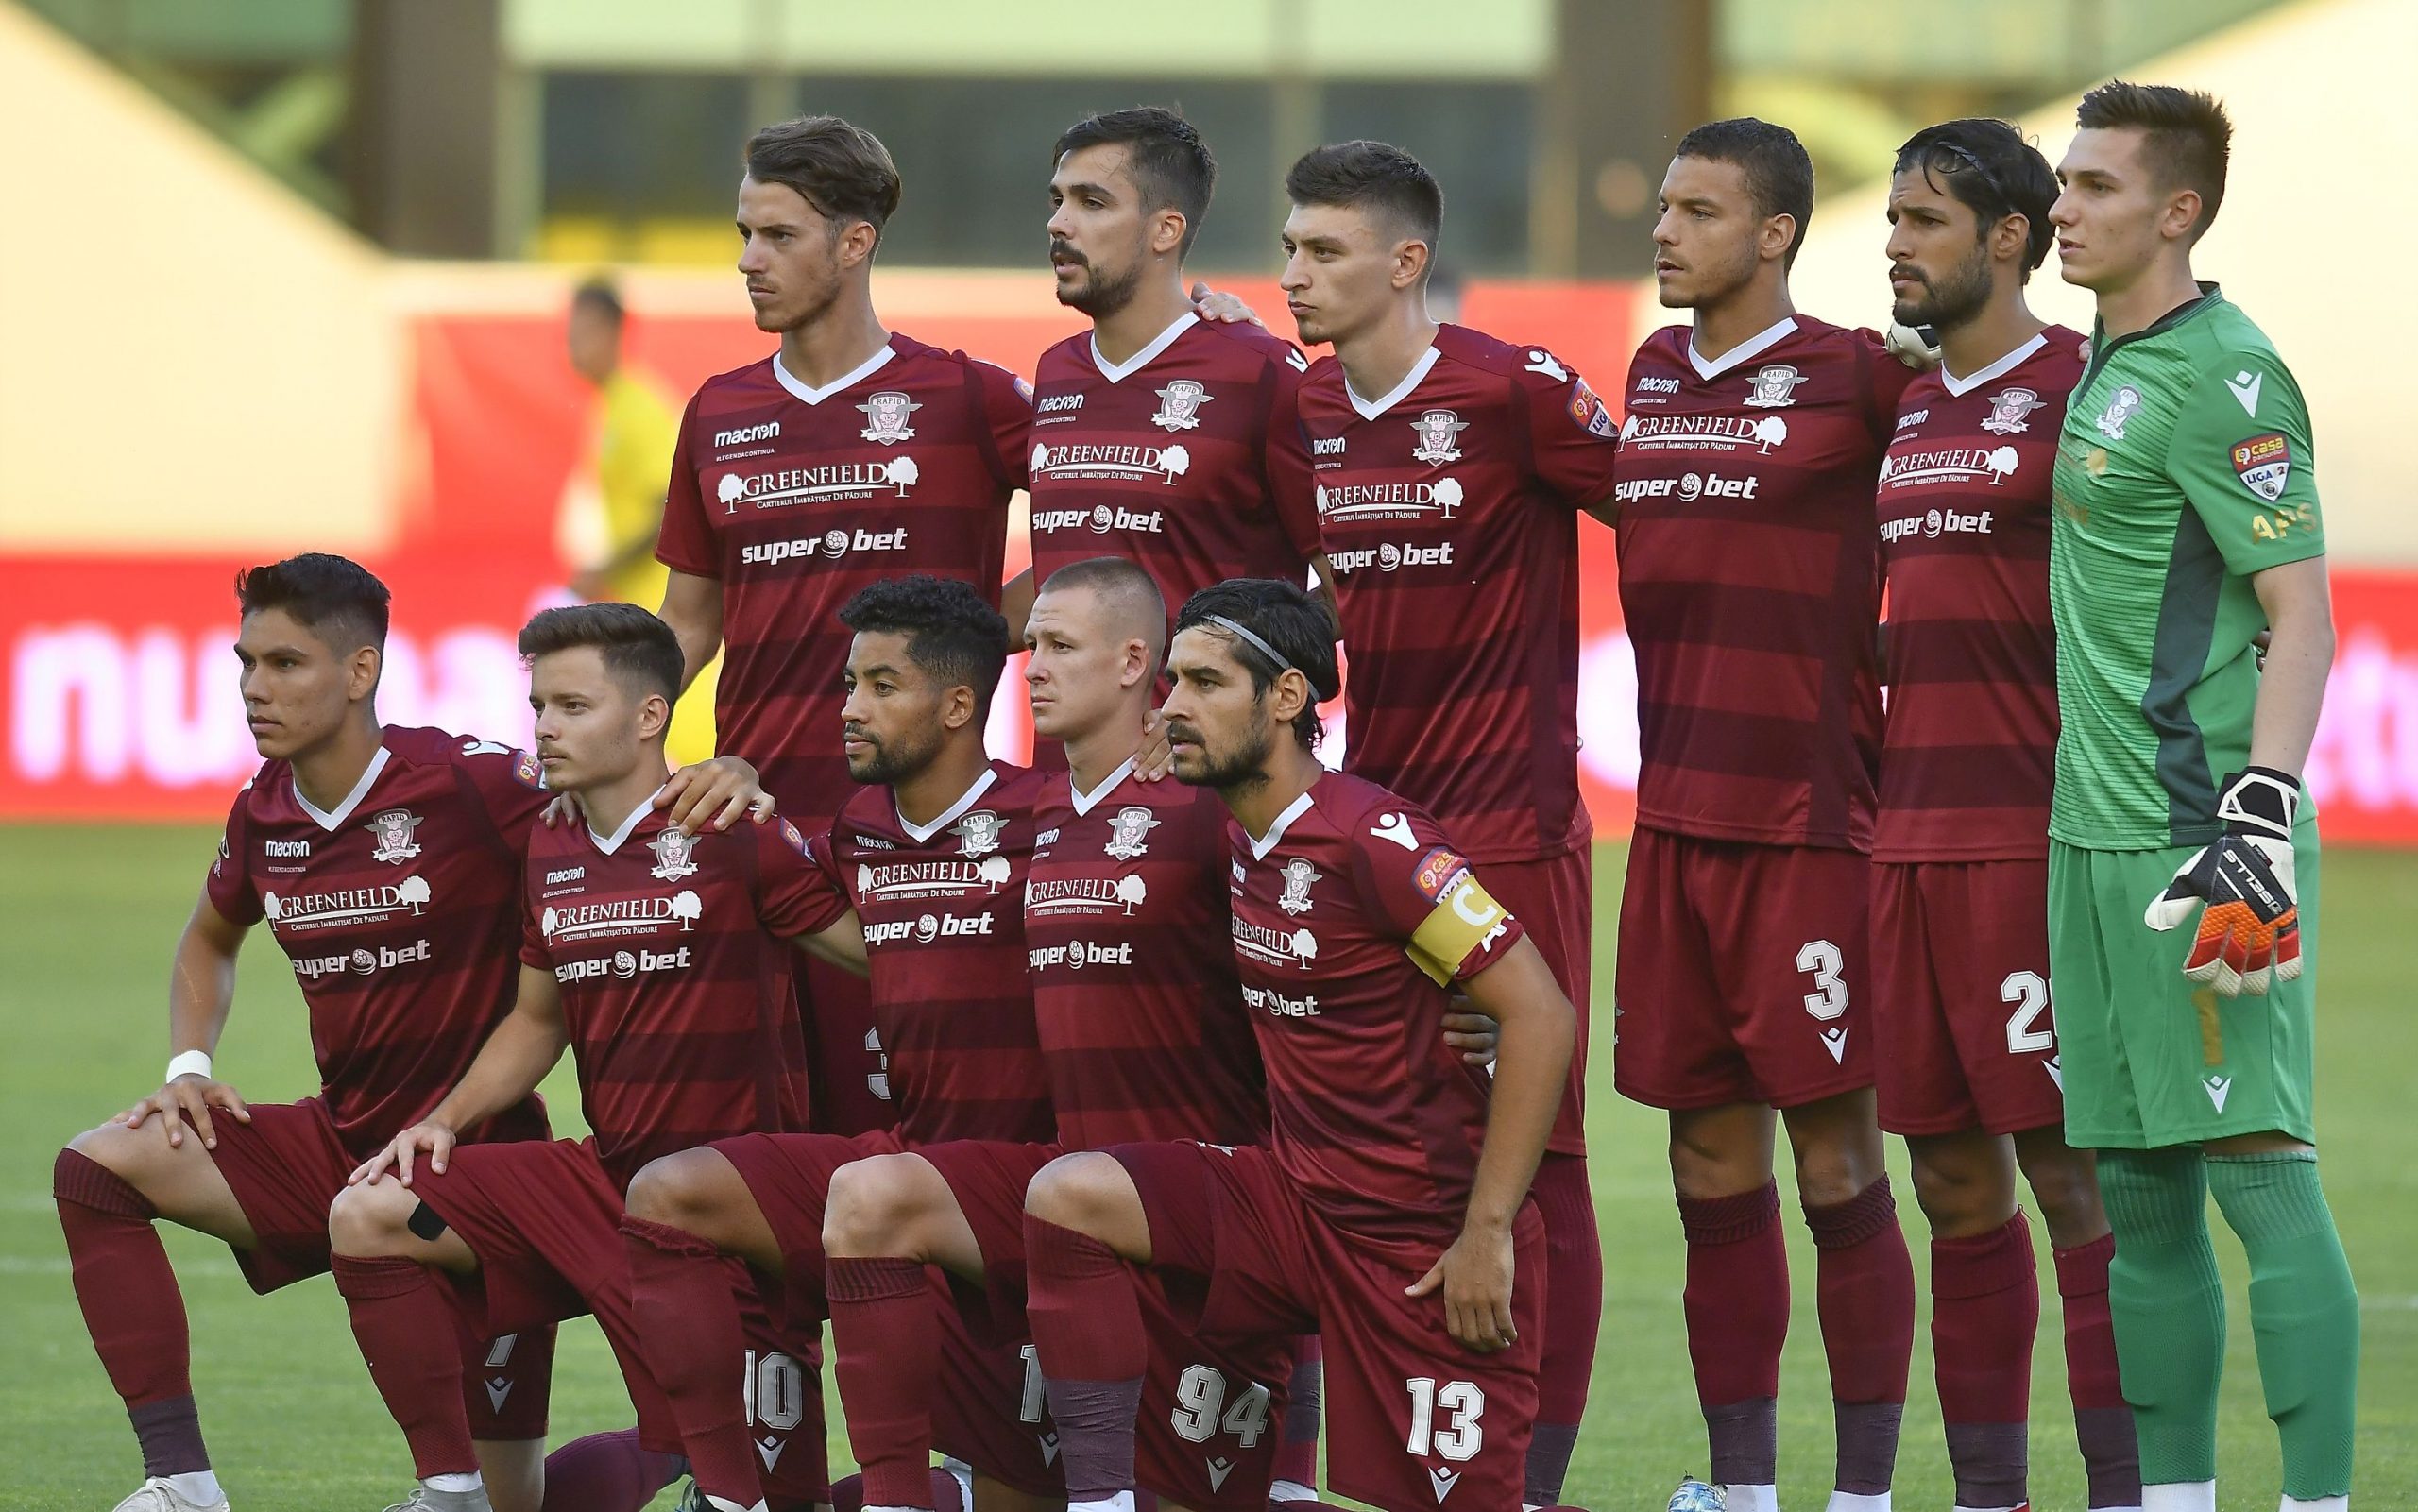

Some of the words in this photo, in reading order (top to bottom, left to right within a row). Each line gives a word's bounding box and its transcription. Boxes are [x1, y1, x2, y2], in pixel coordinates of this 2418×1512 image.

[1174, 385, 1198, 394] RAPID
[1636, 377, 1679, 394] macron
[2007, 392, 2031, 400] RAPID
[1037, 394, 1084, 414] macron
[1428, 415, 1451, 423] RAPID
[1592, 411, 1608, 433] LIG
[1634, 416, 1757, 438] GREENFIELD
[714, 421, 780, 448] macron
[2251, 437, 2284, 455] casa
[1045, 445, 1161, 467] GREENFIELD
[1890, 450, 1990, 476] GREENFIELD
[743, 463, 888, 497] GREENFIELD
[2246, 470, 2273, 484] LIGA
[2277, 466, 2285, 475] 2
[1326, 484, 1434, 509] GREENFIELD
[1615, 479, 1678, 503] super
[1703, 473, 1759, 500] bet
[1032, 509, 1090, 534] super
[1114, 506, 1164, 533] bet
[1880, 517, 1924, 543] super
[1944, 509, 1993, 534] bet
[741, 537, 822, 565] super
[852, 527, 908, 551] bet
[1327, 550, 1377, 574] super
[1403, 541, 1454, 566] bet
[382, 813, 405, 824] RAPID
[967, 816, 990, 825] RAPID
[1125, 812, 1146, 821] RAPID
[266, 841, 310, 858] macron
[546, 866, 585, 885] macron
[871, 862, 980, 887] GREENFIELD
[280, 886, 400, 918] GREENFIELD
[1030, 879, 1118, 903] GREENFIELD
[554, 898, 673, 929] GREENFIELD
[1453, 884, 1498, 926] C
[864, 921, 915, 946] super
[941, 911, 995, 936] bet
[1232, 912, 1293, 953] GREENFIELD
[292, 956, 349, 979] super
[379, 939, 431, 968] bet
[555, 957, 612, 984] super
[639, 946, 691, 972] bet
[1087, 942, 1133, 965] bet
[1796, 939, 1848, 1020] 3
[1278, 994, 1320, 1016] bet
[2001, 970, 2058, 1054] 2
[1170, 1363, 1271, 1449] 94
[1405, 1377, 1485, 1462] 13
